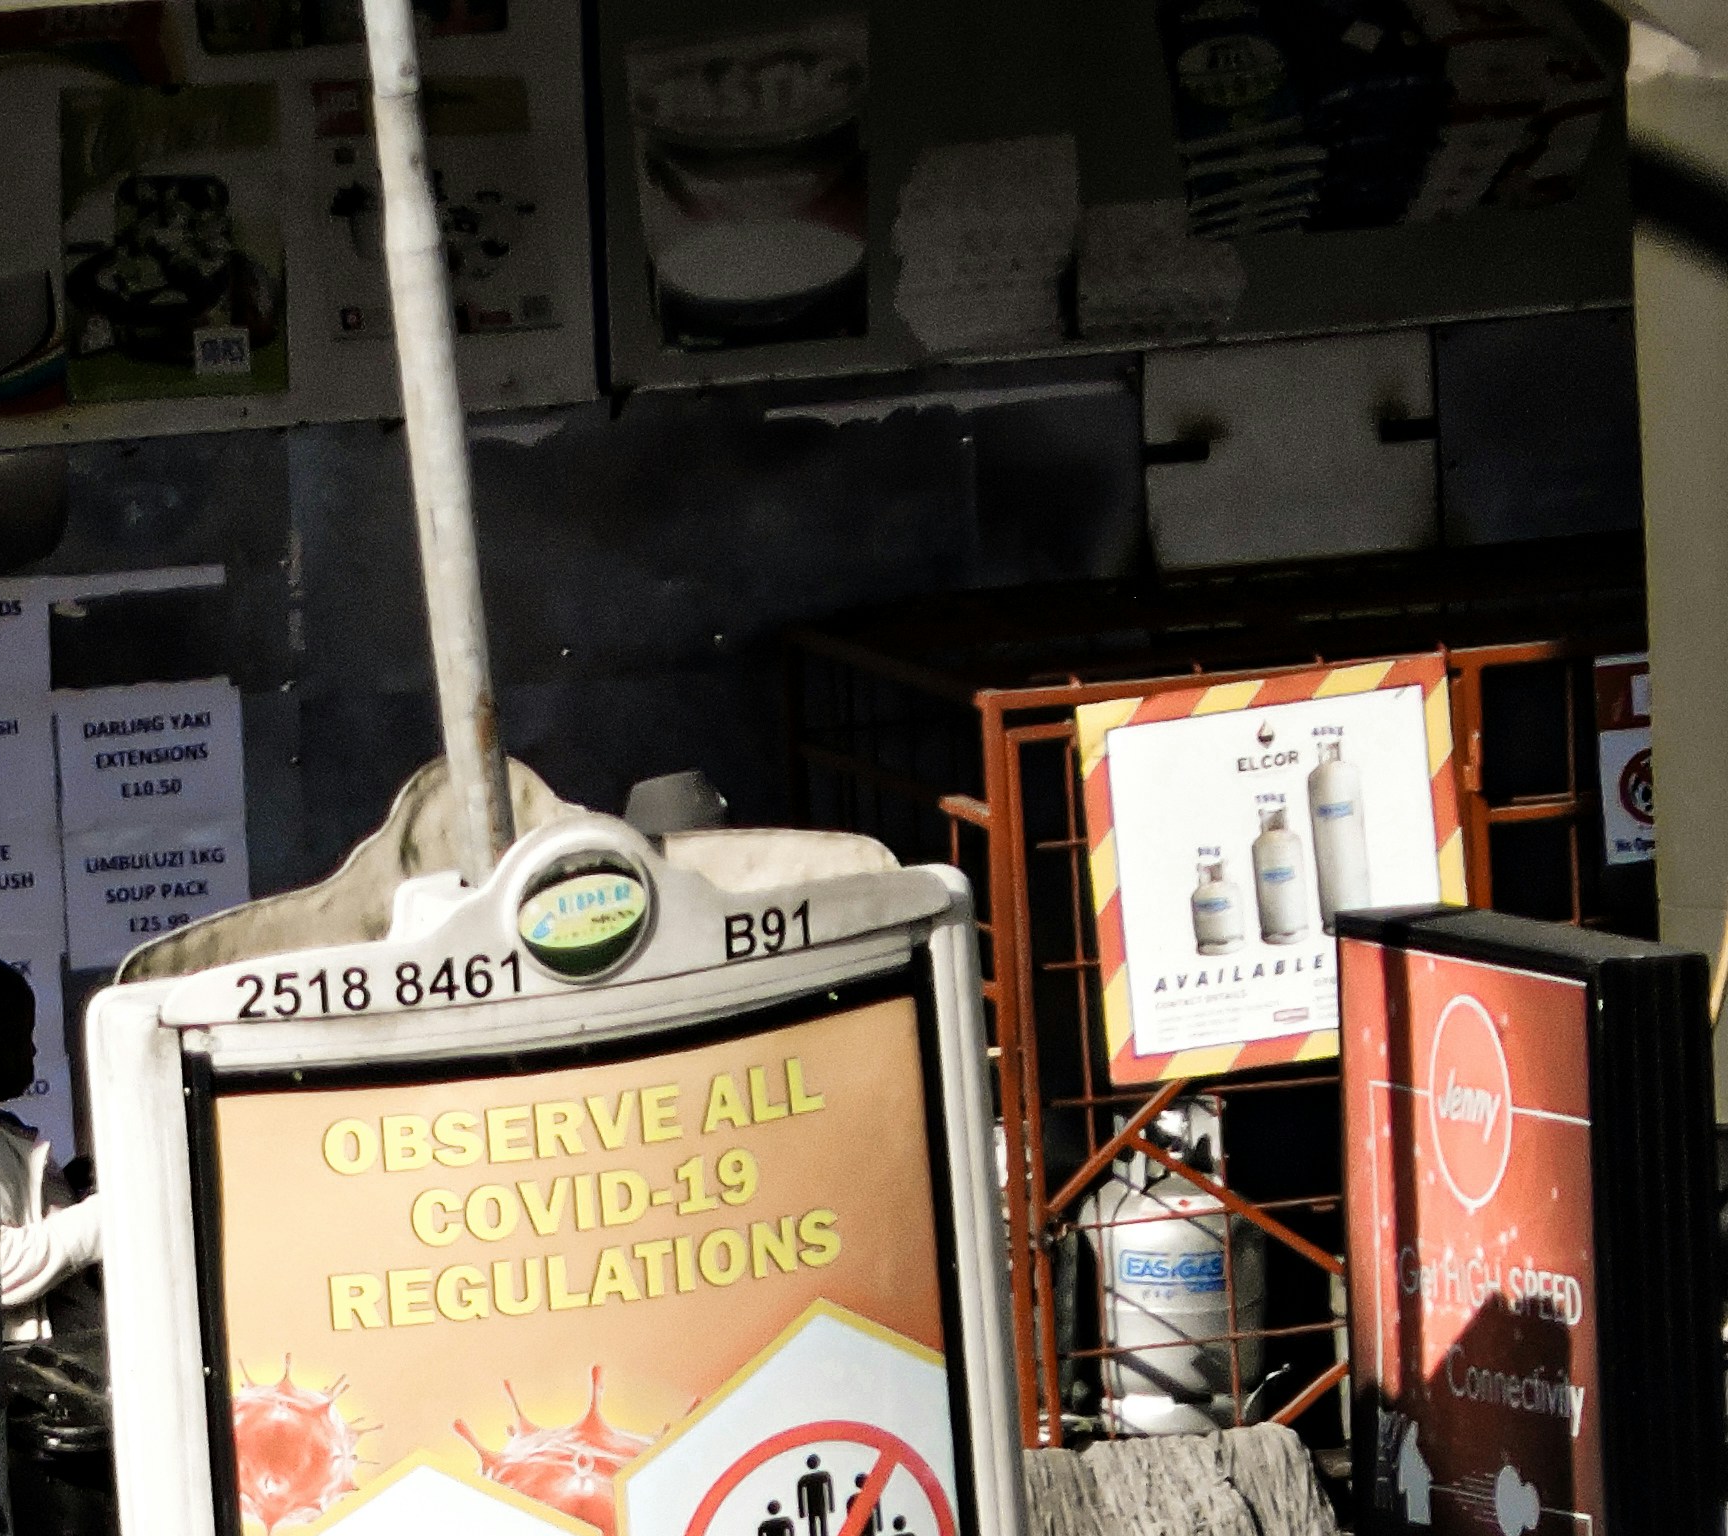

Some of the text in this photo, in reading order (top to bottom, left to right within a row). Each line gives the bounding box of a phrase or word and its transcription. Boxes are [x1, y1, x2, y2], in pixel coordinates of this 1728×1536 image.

[83, 715, 165, 739] DARLING
[95, 742, 209, 769] EXTENSIONS
[122, 778, 183, 799] E10.50
[1237, 750, 1300, 773] ELCOR
[190, 847, 226, 865] 1KG
[105, 879, 209, 904] SOUP PACK
[724, 900, 813, 961] B91
[235, 950, 523, 1020] 2518 8461
[1154, 951, 1325, 994] AVAILABLE
[322, 1057, 826, 1176] OBSERVE ALL
[1437, 1069, 1502, 1142] Jenny
[411, 1148, 761, 1248] COVID-19
[329, 1209, 843, 1332] REGULATIONS
[1508, 1266, 1583, 1326] SPEED
[1446, 1343, 1585, 1439] Connectivity
